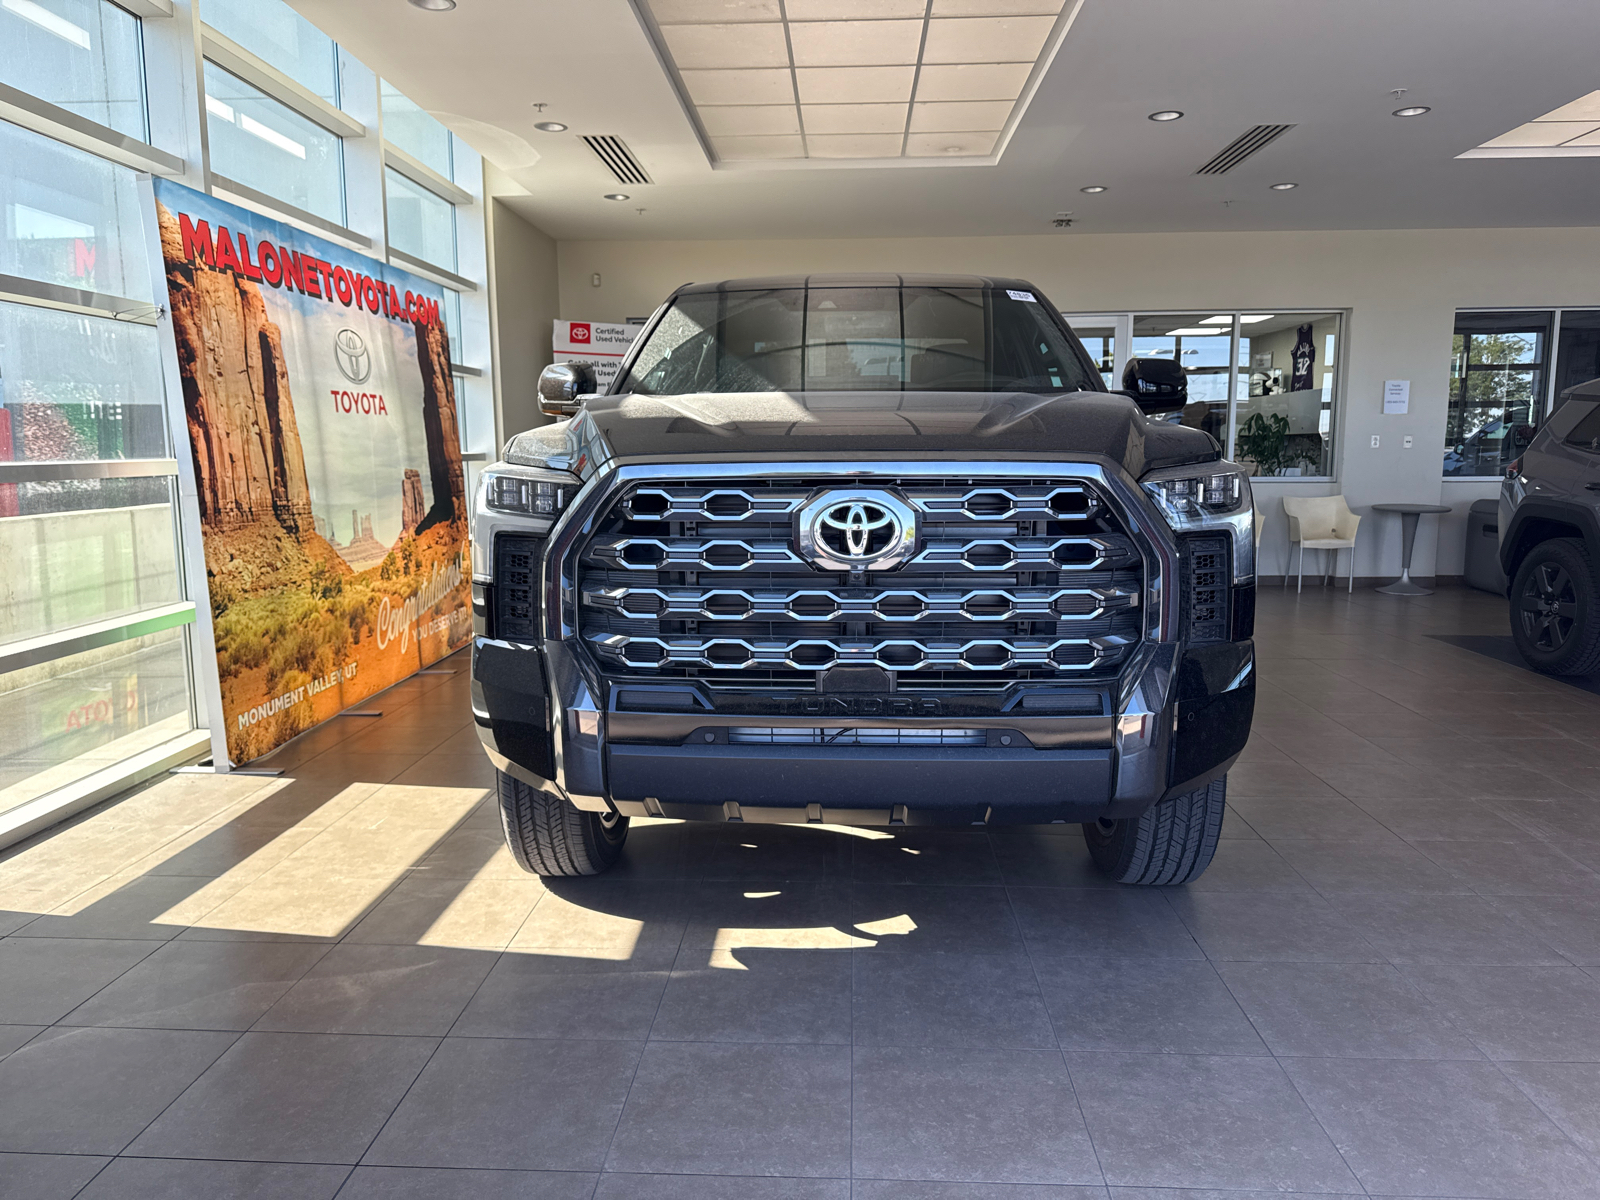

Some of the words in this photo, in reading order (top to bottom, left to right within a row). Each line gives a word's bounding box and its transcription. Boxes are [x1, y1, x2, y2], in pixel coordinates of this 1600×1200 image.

[178, 212, 441, 327] MALONETOYOTA.COM
[595, 327, 625, 336] Certified
[595, 335, 613, 343] Used
[614, 336, 634, 344] Vehicl
[1296, 358, 1310, 376] 32
[331, 390, 388, 416] TOYOTA
[412, 624, 428, 642] YOU
[428, 610, 458, 635] DESERVE
[238, 687, 304, 731] MONUMENT
[307, 671, 344, 697] VALLEY,
[345, 662, 358, 679] UT
[771, 697, 943, 715] TUNDRA
